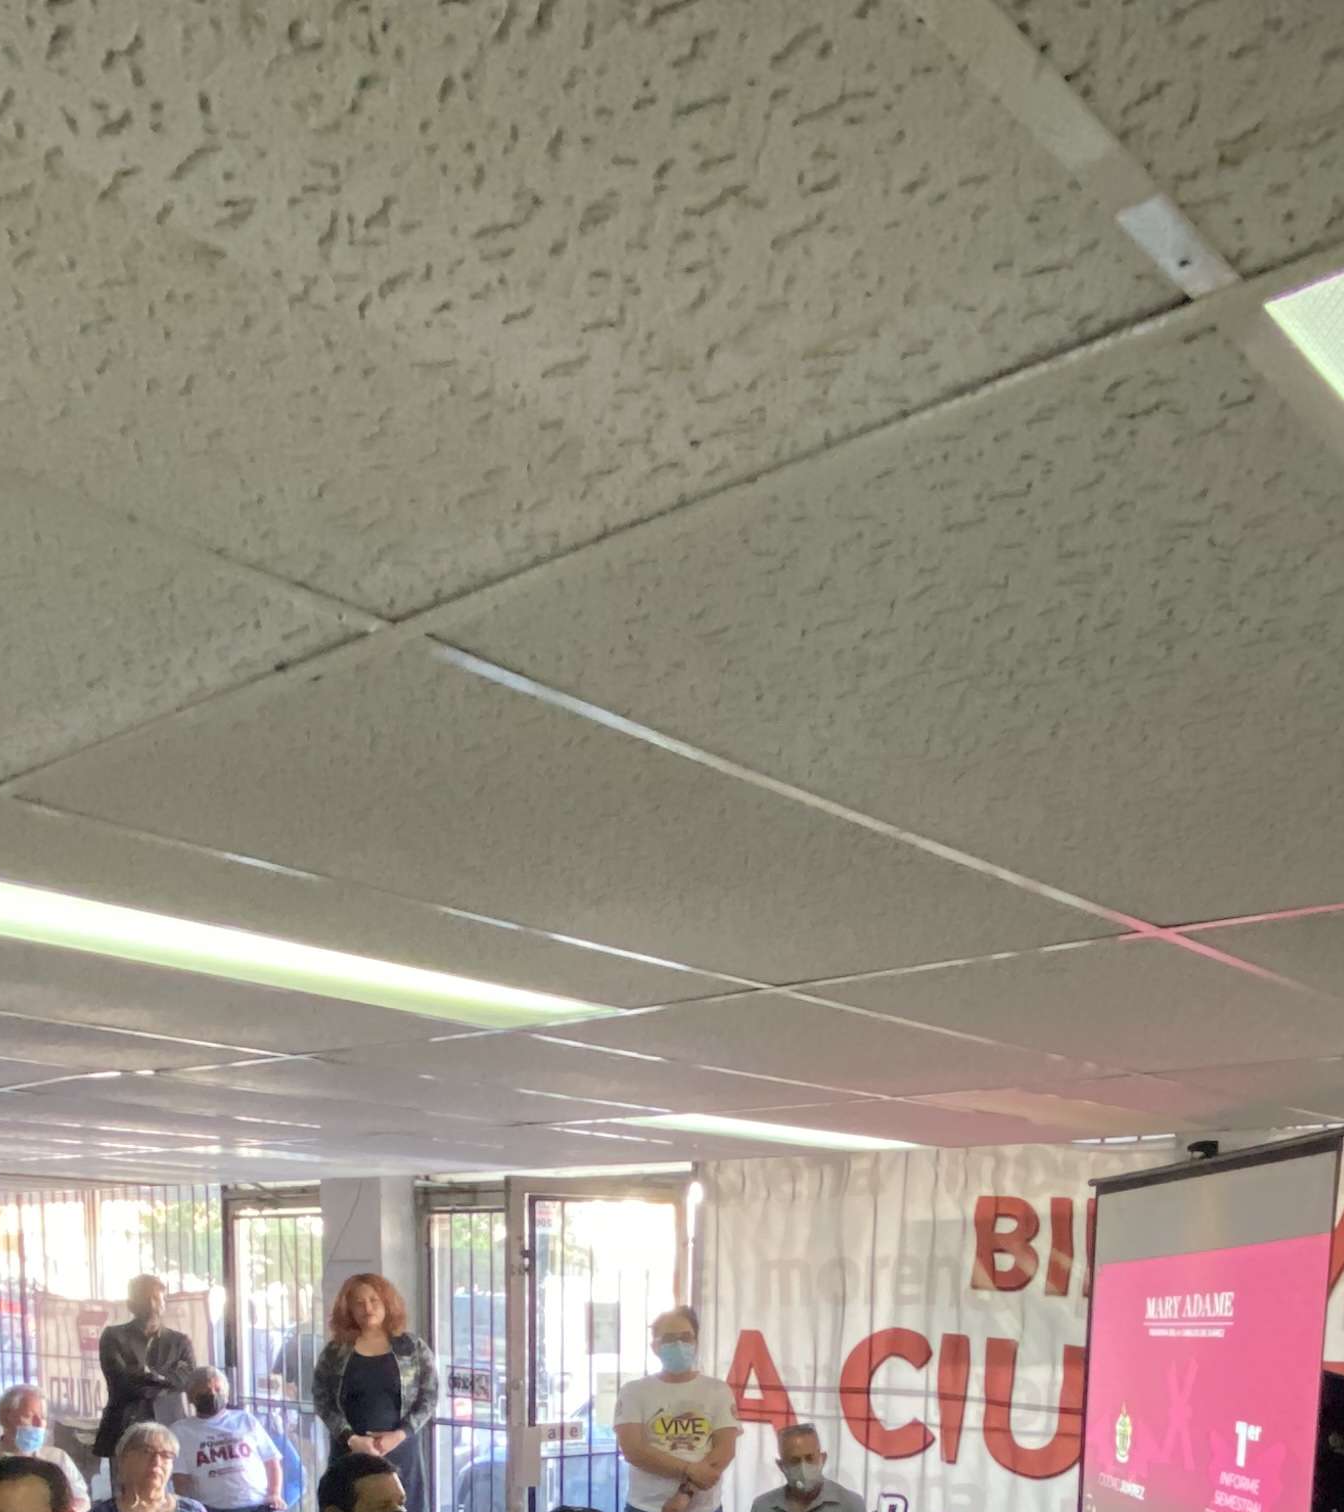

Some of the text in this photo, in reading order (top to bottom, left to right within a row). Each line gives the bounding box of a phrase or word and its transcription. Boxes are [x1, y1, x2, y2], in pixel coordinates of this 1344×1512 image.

[1145, 1292, 1234, 1319] MARY ADAME
[726, 1330, 798, 1432] A
[660, 1417, 706, 1435] VIVE
[197, 1443, 251, 1467] AMLO
[1219, 1472, 1261, 1495] INFORME
